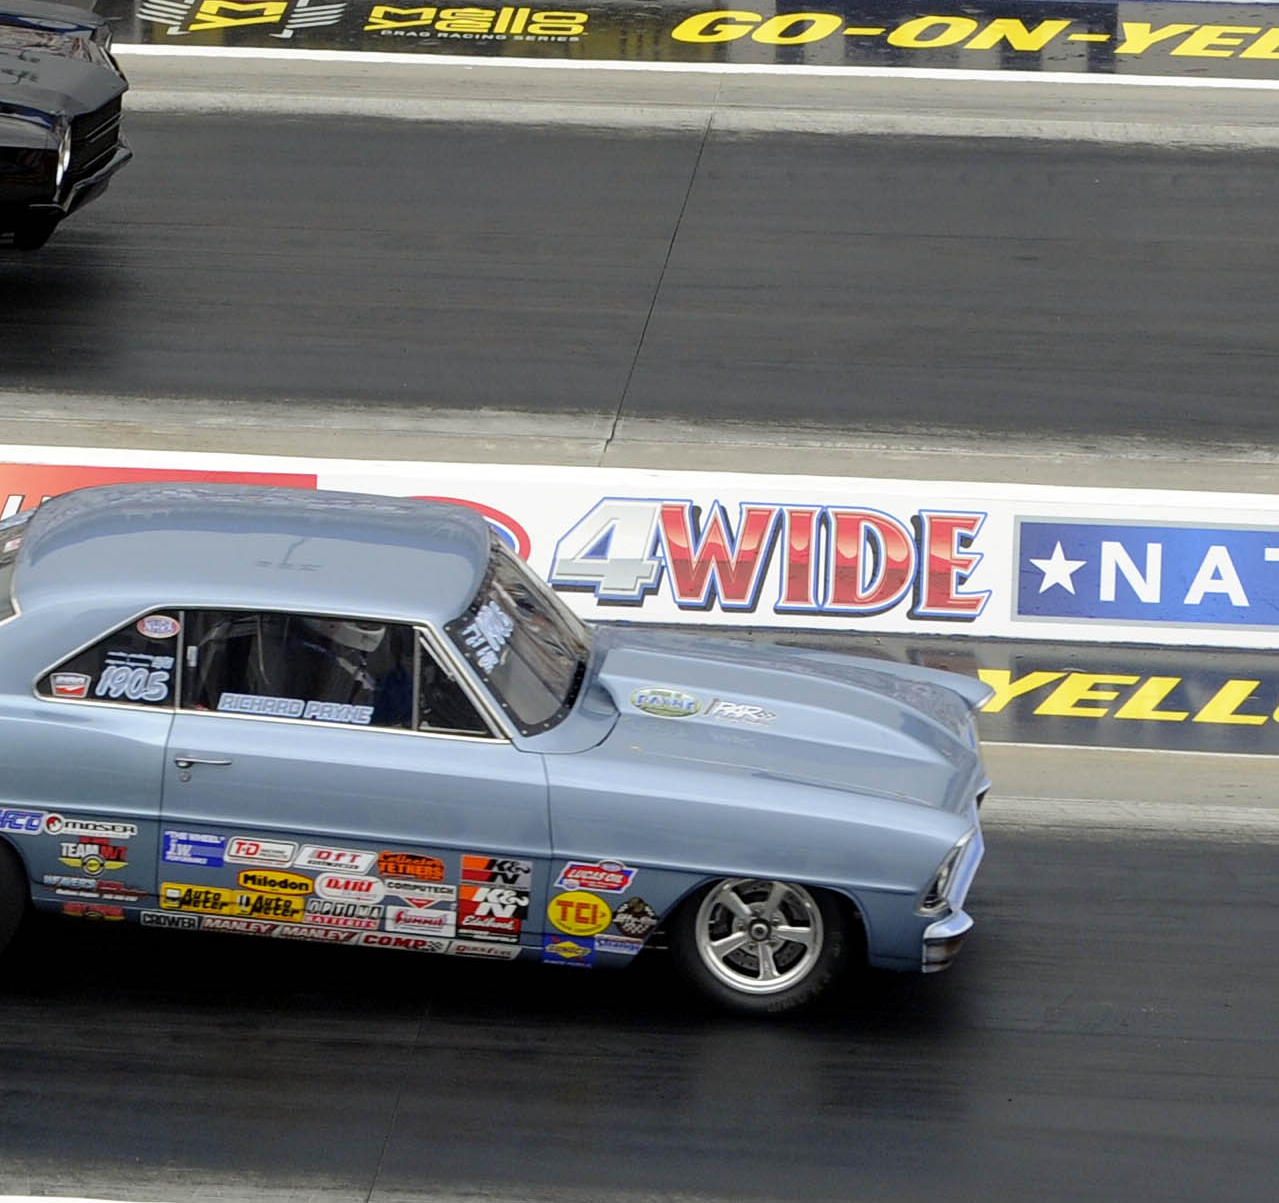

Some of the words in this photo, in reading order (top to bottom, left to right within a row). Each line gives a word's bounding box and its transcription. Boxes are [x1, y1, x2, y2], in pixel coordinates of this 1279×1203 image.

[381, 29, 431, 39] DRAG
[437, 31, 508, 41] RACING
[515, 34, 580, 43] SERIES
[95, 666, 170, 701] 1905
[977, 669, 1279, 726] YELL
[218, 693, 305, 717] RICHARD
[304, 701, 374, 725] PAYNE
[64, 821, 135, 834] MOSER
[61, 843, 99, 857] TEAM
[379, 864, 443, 880] TETHERS
[568, 869, 604, 881] LUCAS
[243, 874, 309, 891] Milodon
[326, 879, 375, 893] DART
[387, 881, 453, 894] COMPUTECH
[183, 889, 222, 901] Auto
[254, 896, 292, 908] Auto
[180, 898, 230, 910] Meter
[250, 905, 300, 918] Meter
[309, 900, 380, 917] OPTIMA
[556, 900, 599, 925] TCI
[143, 914, 196, 928] CROWER
[203, 919, 270, 932] MANLEY
[283, 926, 349, 942] MANLEY
[364, 934, 427, 947] COMP
